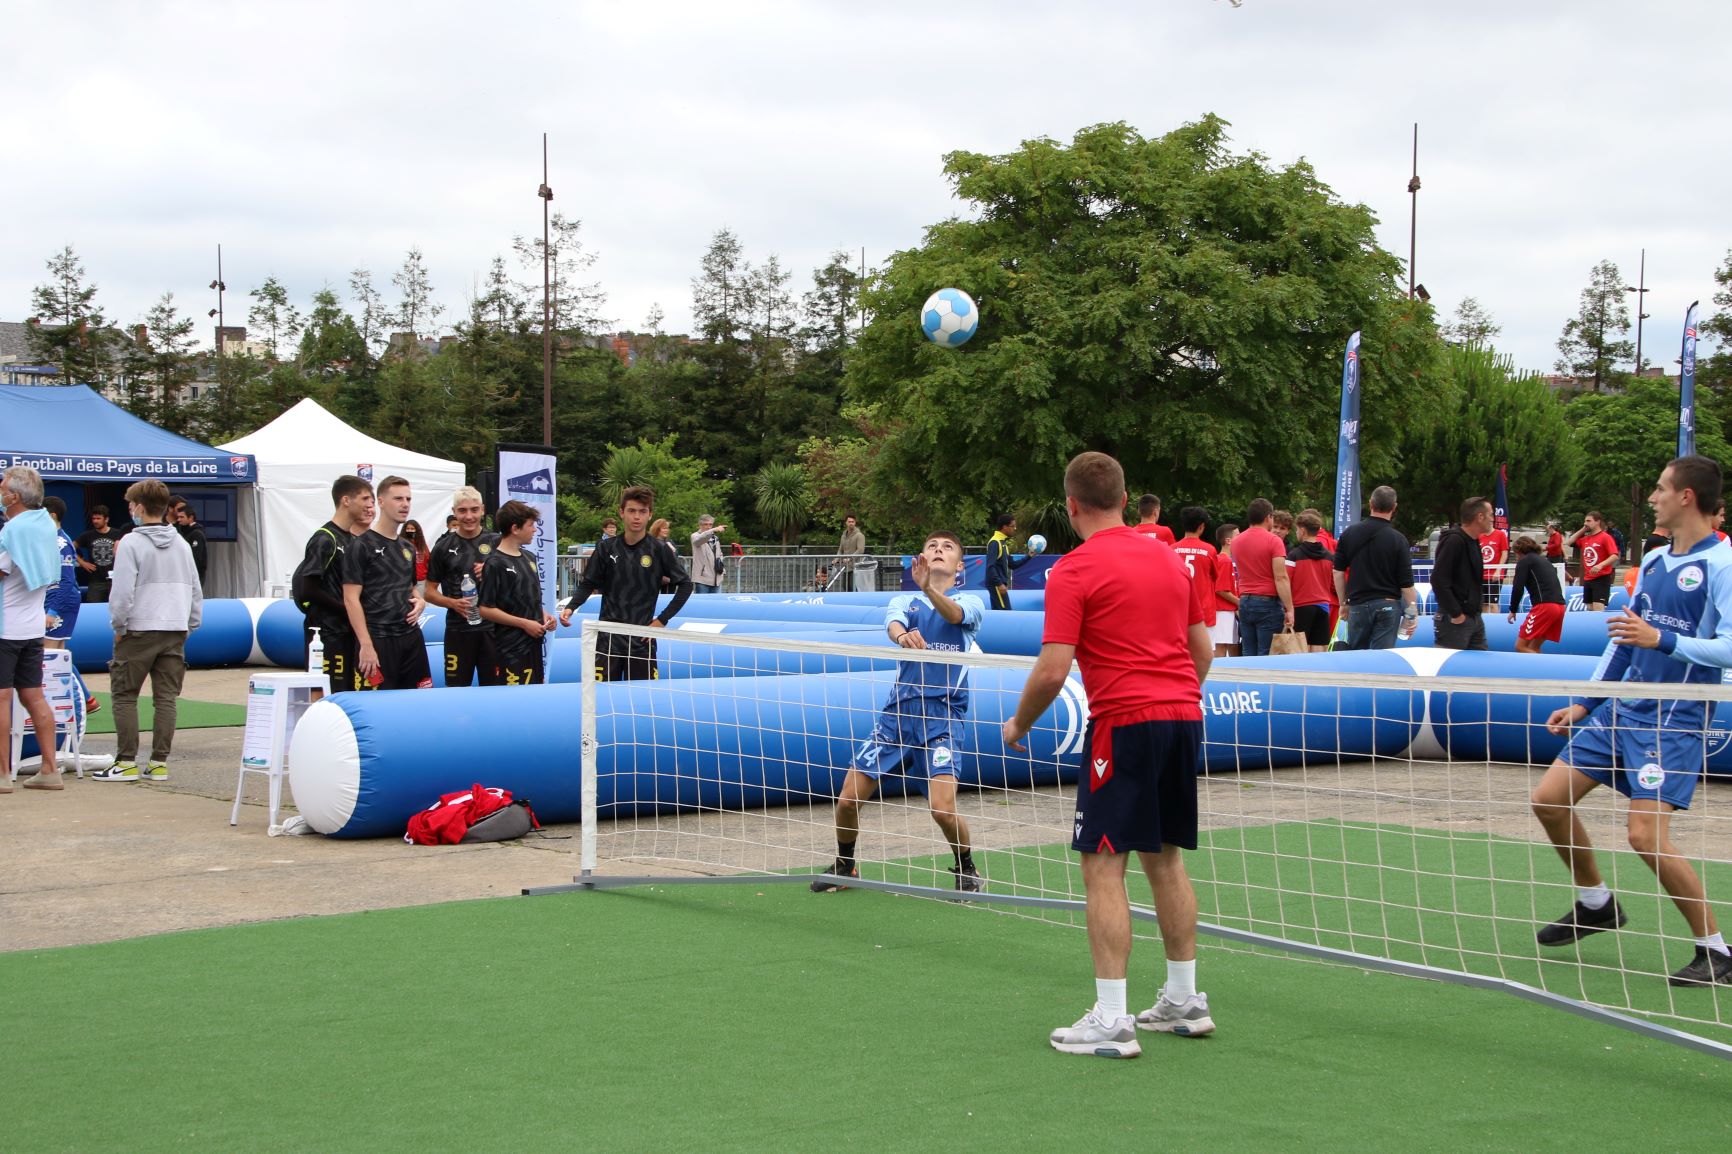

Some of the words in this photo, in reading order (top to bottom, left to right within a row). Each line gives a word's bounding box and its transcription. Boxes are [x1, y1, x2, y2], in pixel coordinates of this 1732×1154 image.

[12, 456, 73, 472] Football
[77, 459, 103, 473] des
[107, 460, 142, 476] Pays
[146, 460, 163, 474] de
[166, 460, 180, 474] la
[183, 461, 218, 474] Loire
[1338, 469, 1347, 522] FOOTBALL
[1185, 555, 1195, 579] 5
[334, 655, 344, 674] 3
[446, 654, 458, 671] 3
[523, 668, 533, 685] 7
[1208, 690, 1264, 716] LOIRE
[855, 739, 883, 768] 14
